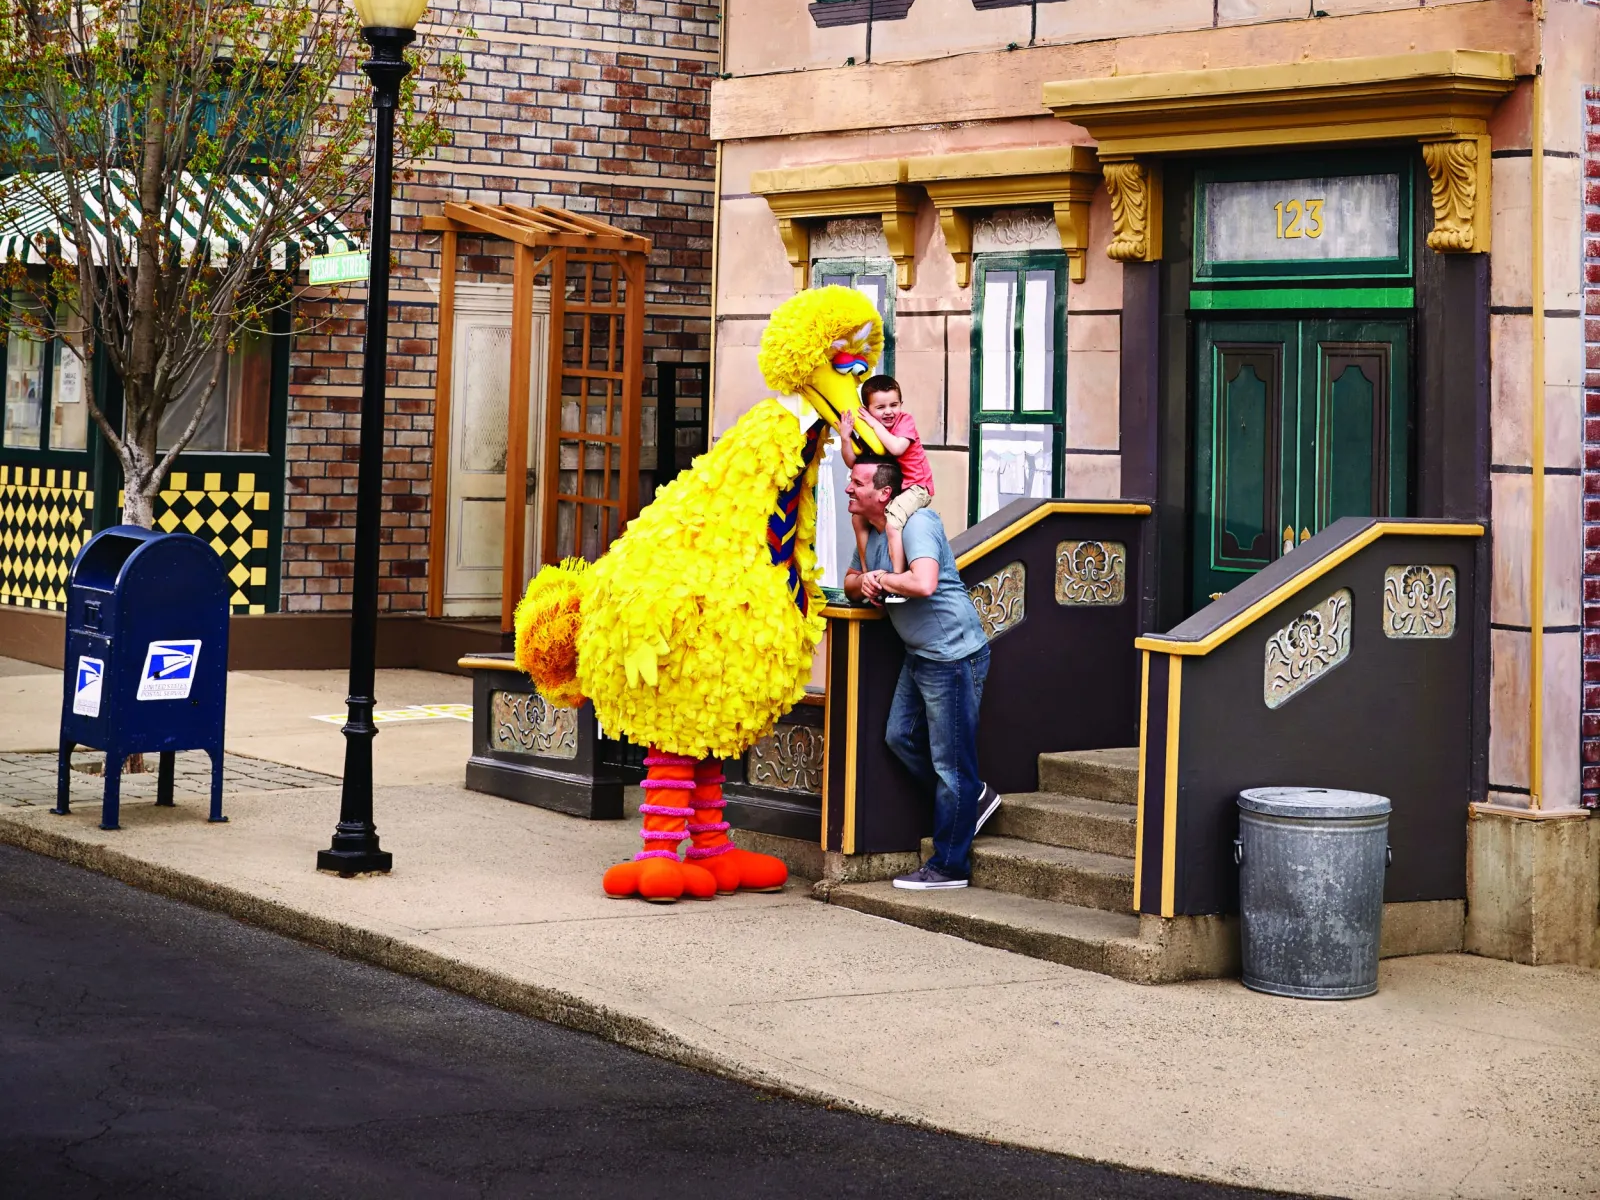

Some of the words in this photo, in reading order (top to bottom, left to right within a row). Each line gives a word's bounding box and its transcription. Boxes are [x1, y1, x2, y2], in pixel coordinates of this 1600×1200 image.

[1274, 199, 1325, 238] 123
[313, 258, 339, 279] SESAME
[342, 254, 368, 276] STREET
